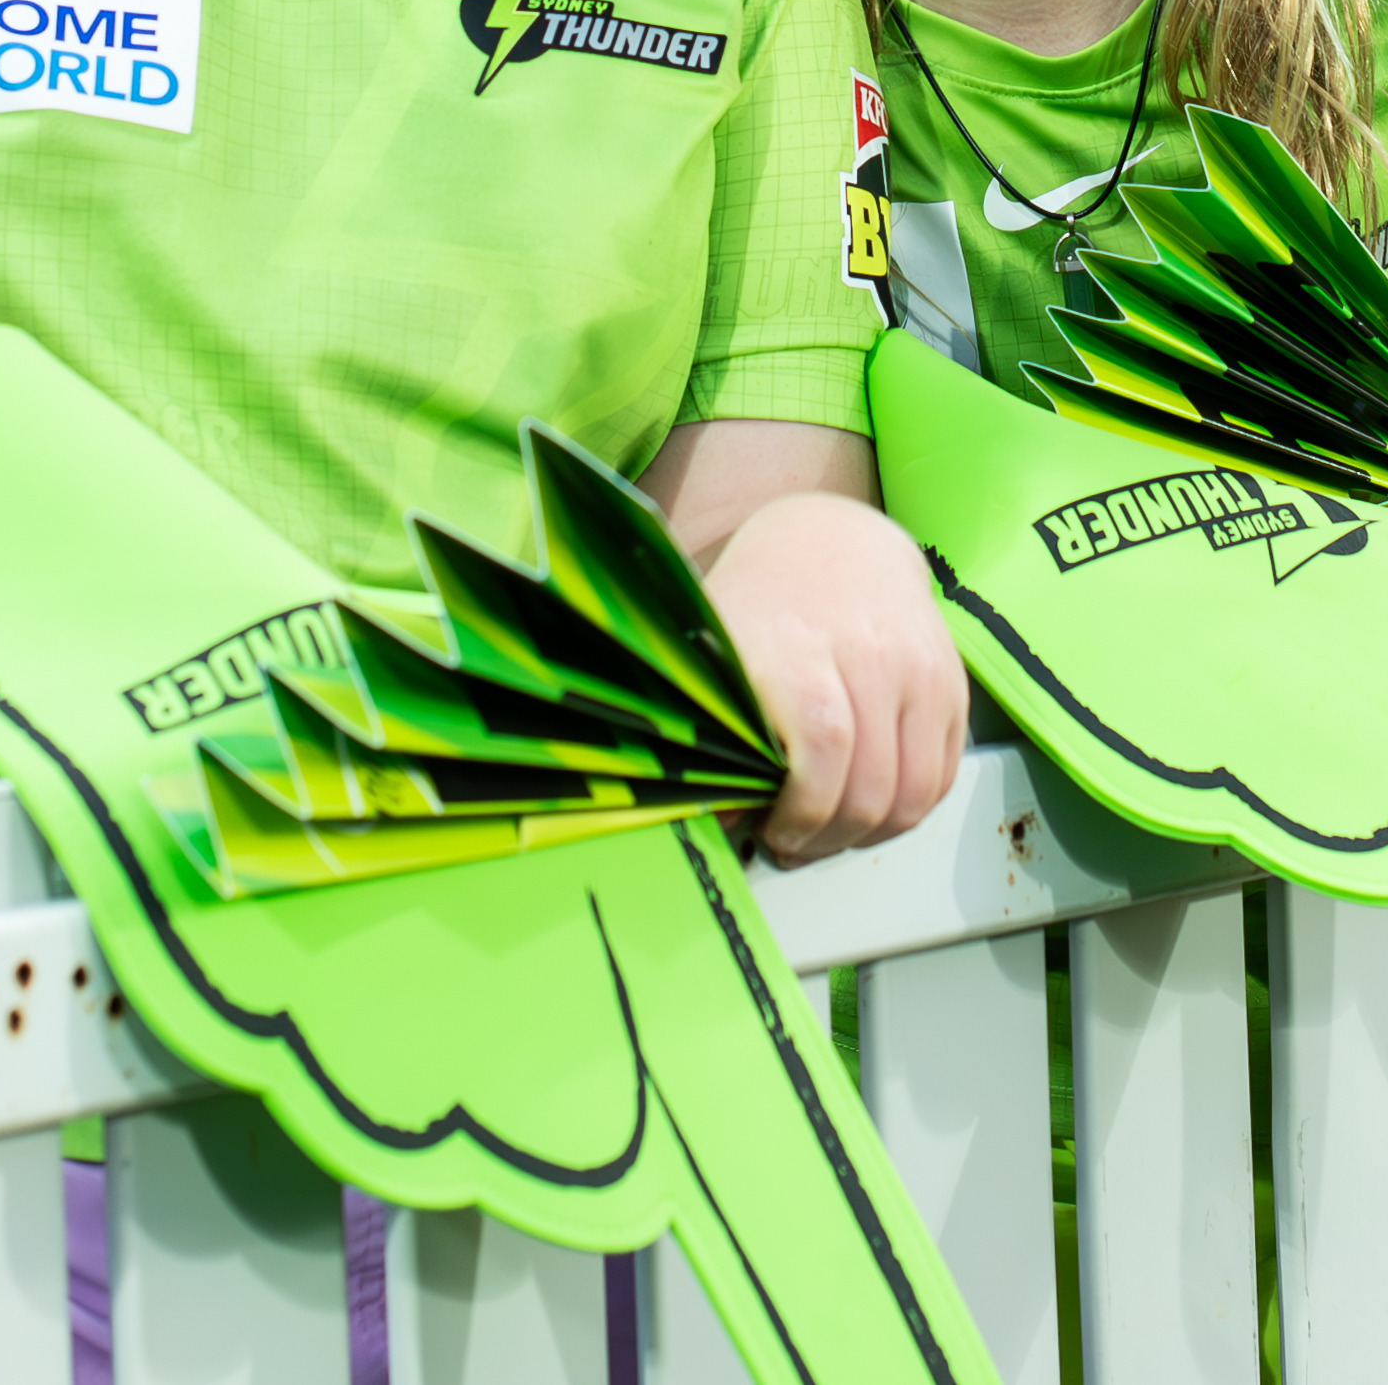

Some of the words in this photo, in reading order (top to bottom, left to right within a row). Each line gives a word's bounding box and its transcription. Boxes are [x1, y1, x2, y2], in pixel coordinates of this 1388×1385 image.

[542, 13, 719, 69] THUNDER
[1043, 472, 1263, 565] THUNDER
[1212, 508, 1299, 548] SYDNEY
[131, 603, 340, 730] UNDER
